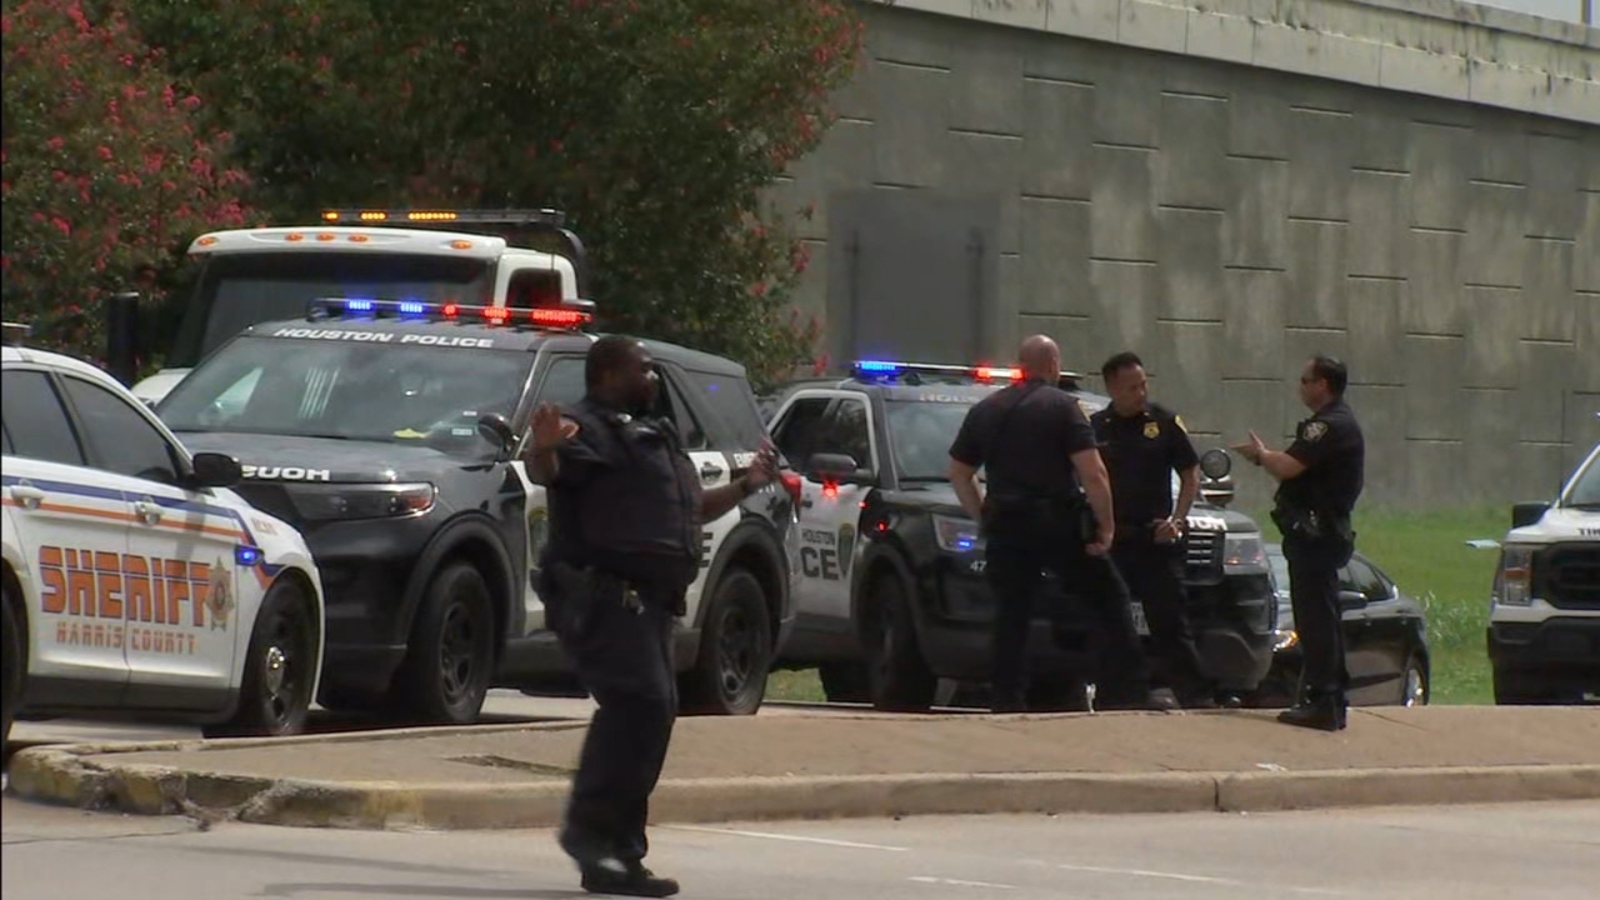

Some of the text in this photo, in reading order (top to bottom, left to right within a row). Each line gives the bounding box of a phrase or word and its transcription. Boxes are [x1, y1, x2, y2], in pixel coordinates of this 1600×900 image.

[274, 327, 494, 348] HOUSTON POLICE
[801, 528, 835, 543] HOUSTON
[39, 545, 210, 627] SHERIFF
[56, 621, 196, 655] HARRIS COUNTY
